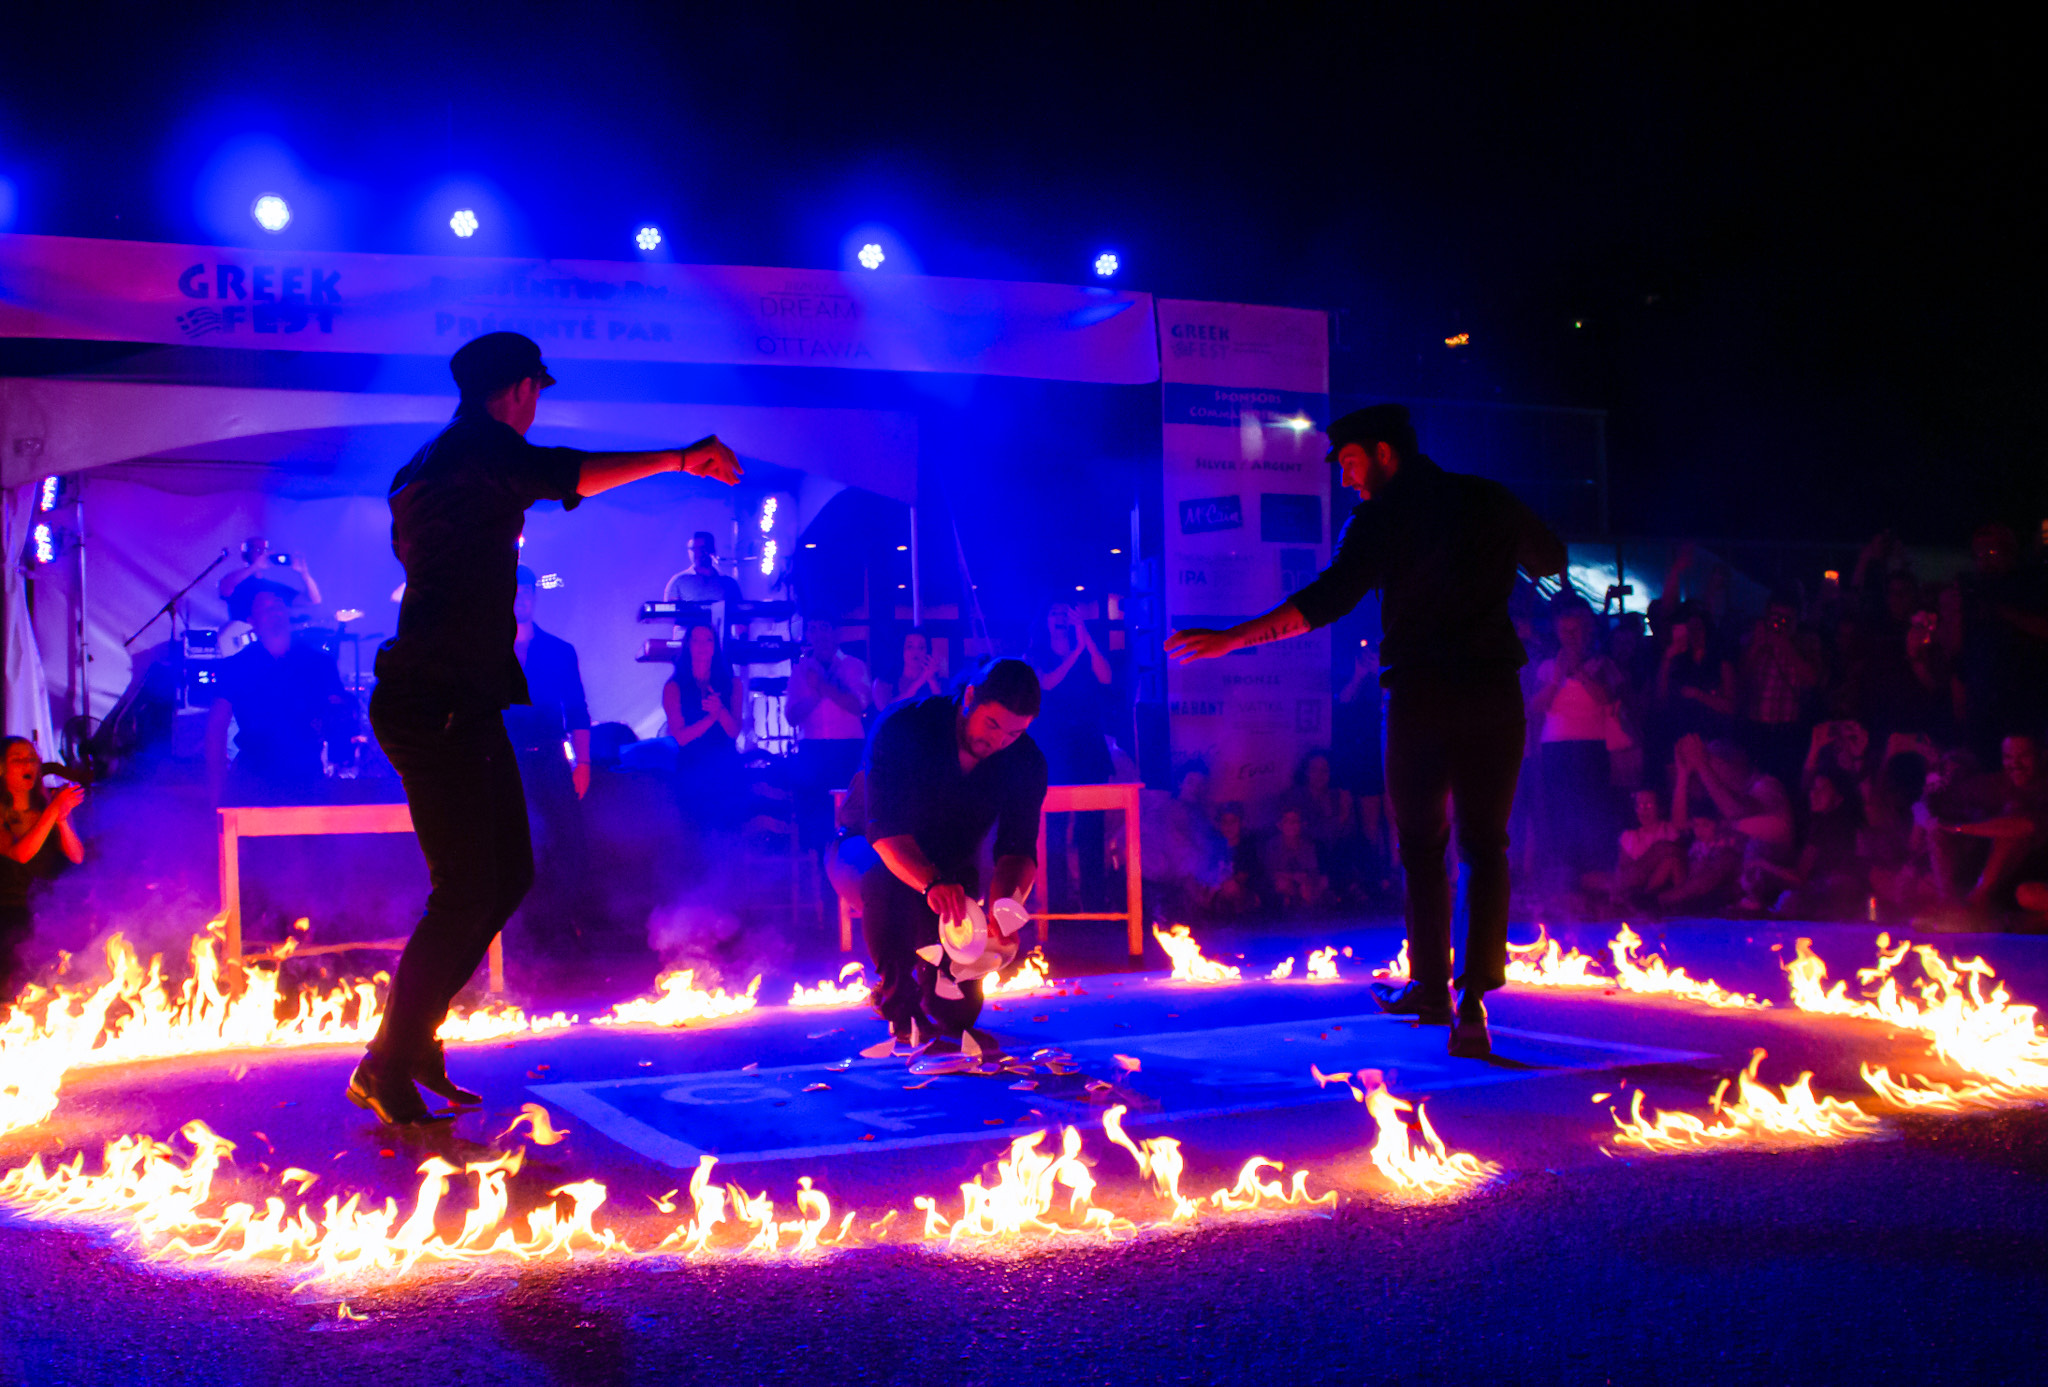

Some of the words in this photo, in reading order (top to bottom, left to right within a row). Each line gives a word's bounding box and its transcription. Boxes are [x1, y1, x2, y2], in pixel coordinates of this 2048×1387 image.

[177, 262, 343, 304] GREEK
[759, 296, 858, 320] DREAM
[607, 319, 674, 343] PAR
[1171, 324, 1230, 341] GREEK
[754, 334, 876, 363] OTTAWA
[1195, 458, 1237, 471] SILVER
[1251, 460, 1303, 472] ARGENT
